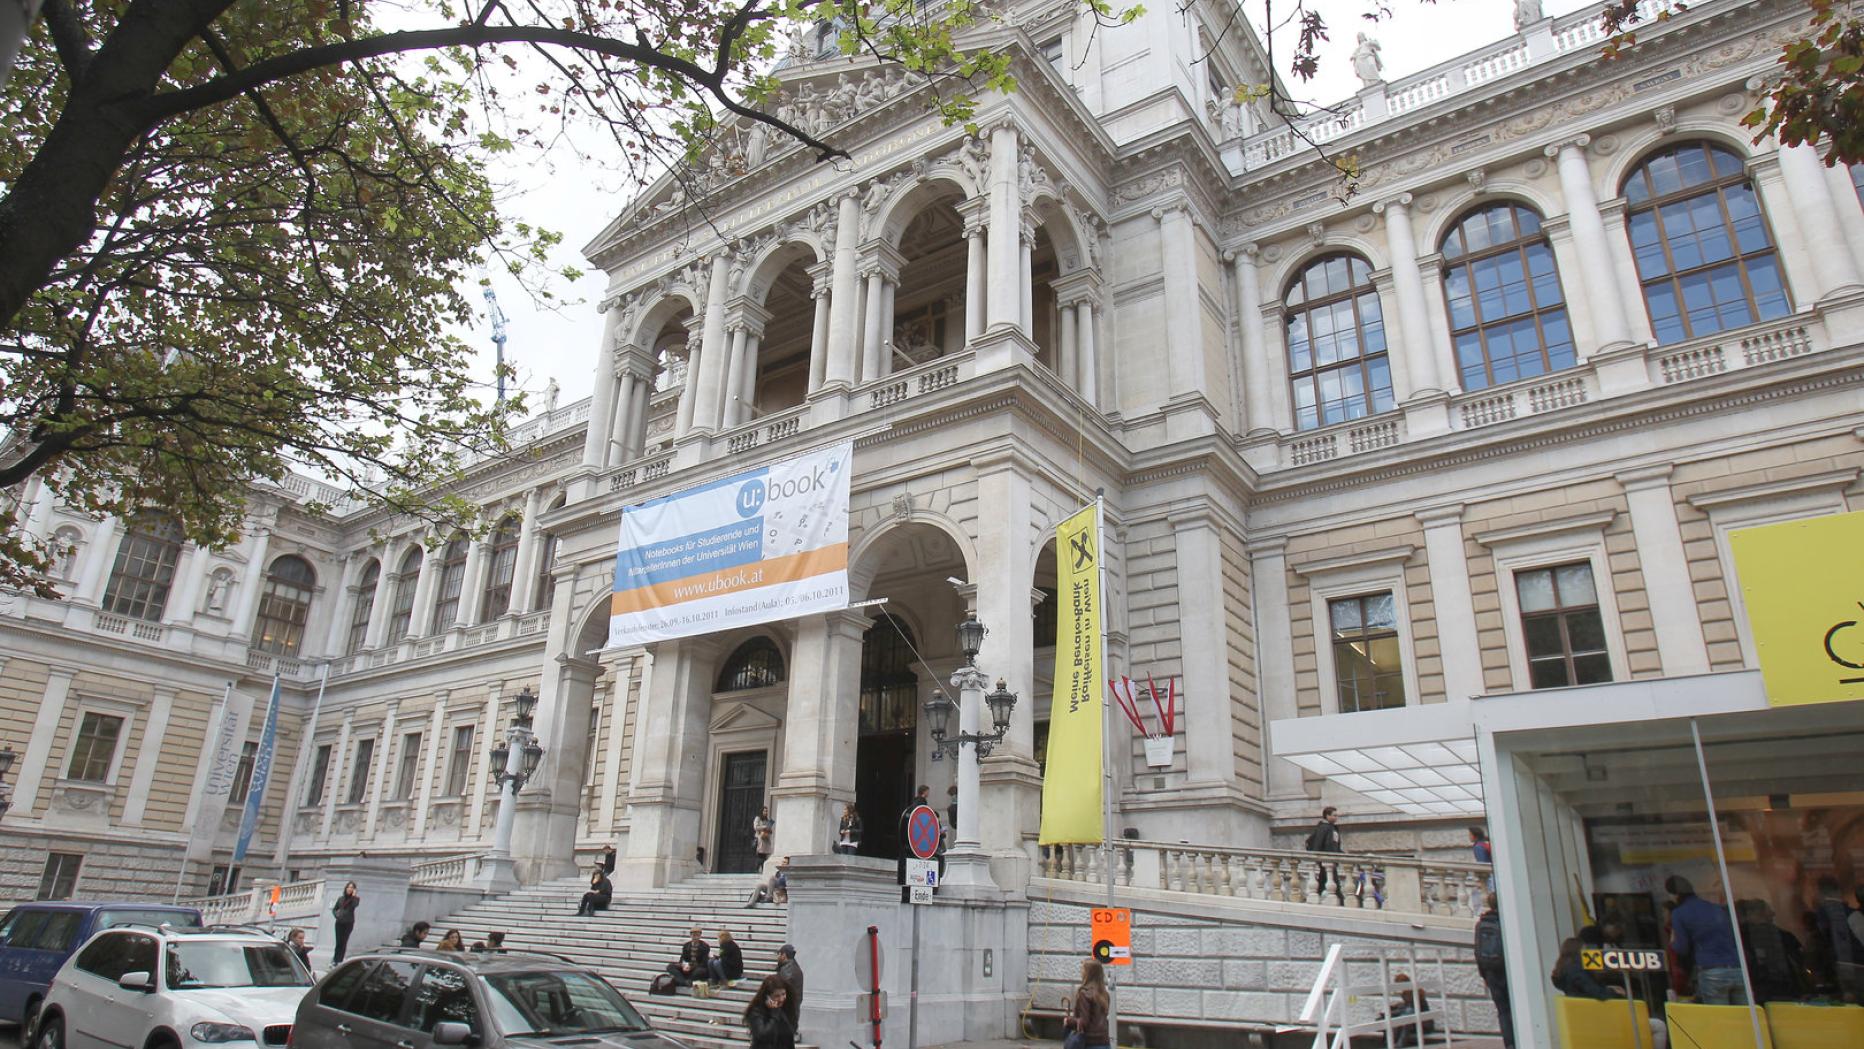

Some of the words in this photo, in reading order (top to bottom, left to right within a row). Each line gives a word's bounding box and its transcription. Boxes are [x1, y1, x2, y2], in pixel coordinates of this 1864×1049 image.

[645, 544, 684, 559] Notebooks
[685, 541, 695, 551] für
[697, 531, 742, 547] Studierende
[743, 525, 759, 536] und
[682, 554, 694, 565] der
[697, 544, 736, 561] Universität
[738, 539, 759, 552] Wien
[673, 569, 763, 598] www.ubook.at
[725, 603, 758, 616] Infostand
[1603, 951, 1662, 969] CLUB
